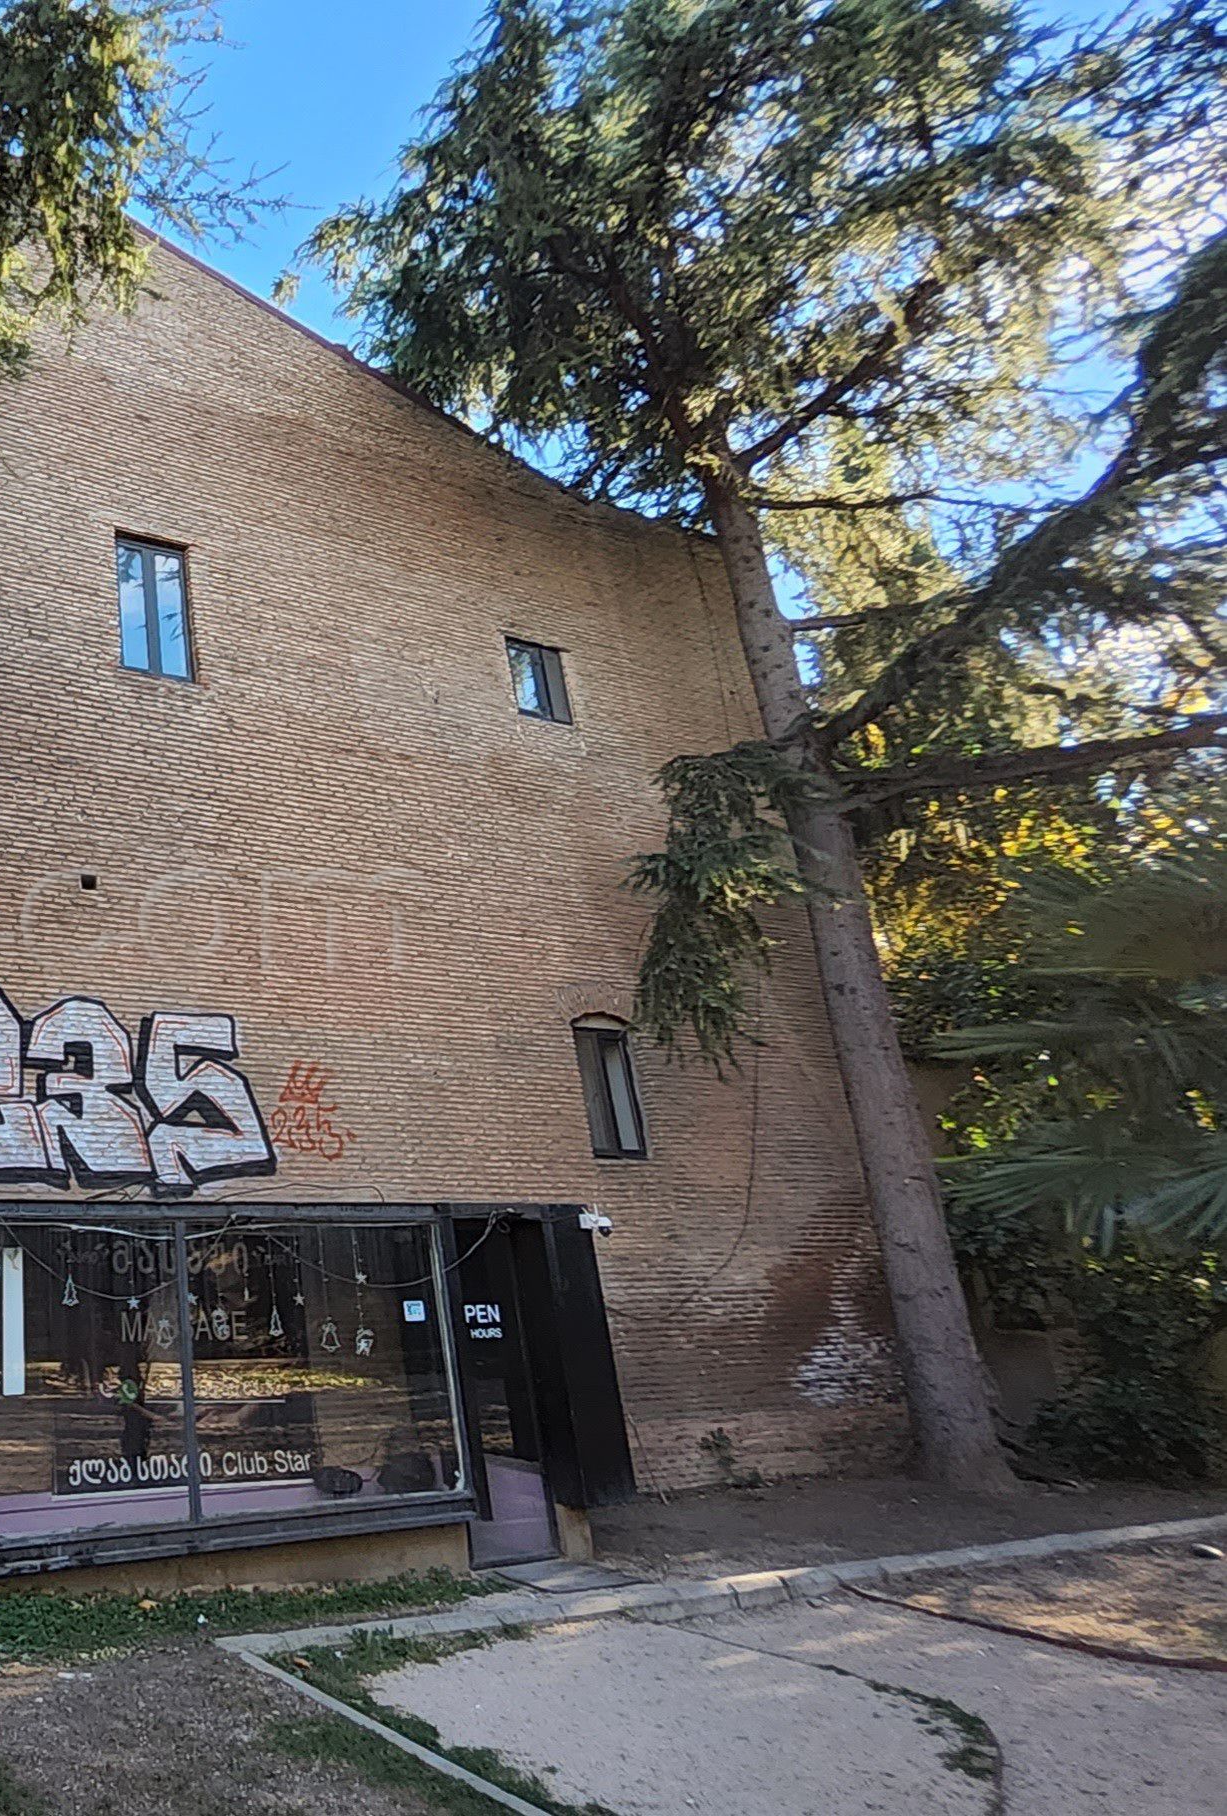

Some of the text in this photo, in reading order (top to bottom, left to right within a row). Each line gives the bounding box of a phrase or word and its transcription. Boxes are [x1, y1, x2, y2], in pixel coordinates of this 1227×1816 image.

[121, 1311, 249, 1342] MASAGE
[469, 1327, 503, 1339] HOURS
[69, 1456, 132, 1486] ქლაბ
[222, 1449, 311, 1476] Club Star
